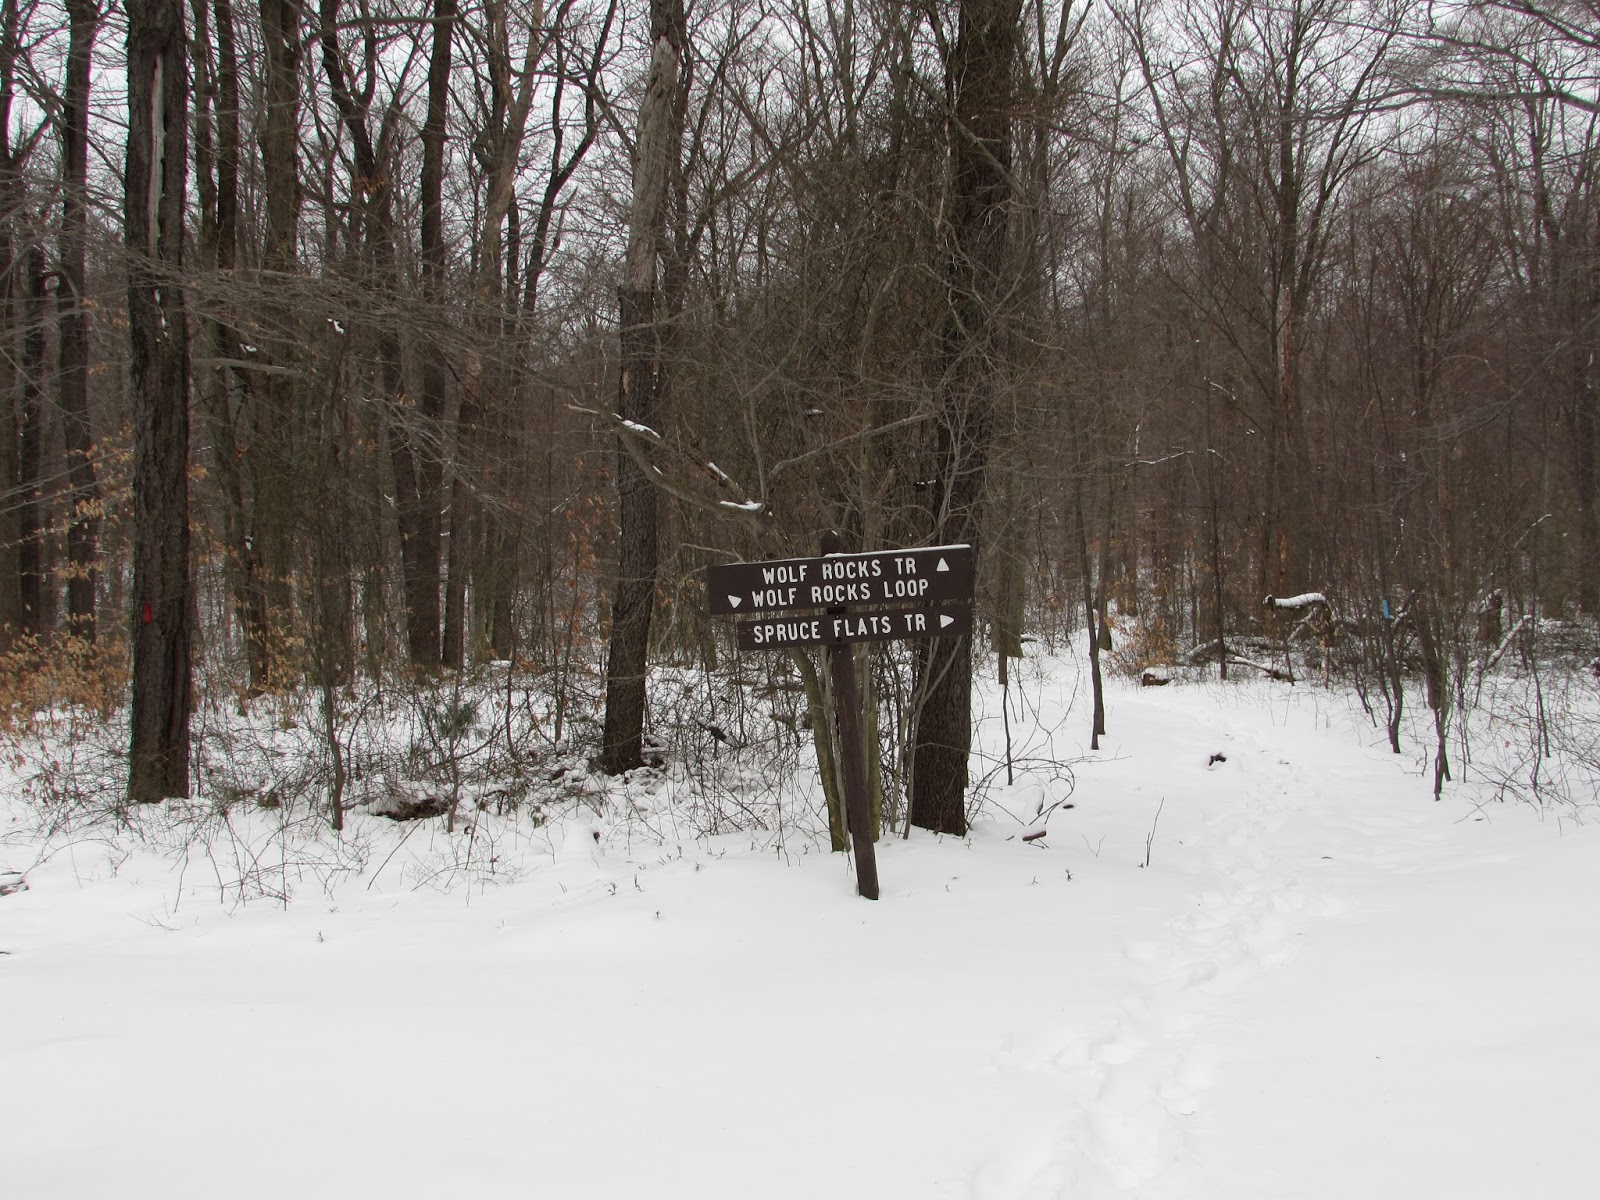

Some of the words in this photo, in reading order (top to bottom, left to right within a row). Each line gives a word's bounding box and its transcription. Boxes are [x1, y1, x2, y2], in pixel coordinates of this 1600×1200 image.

[762, 565, 808, 585] WOLF
[822, 559, 882, 580] ROCKS
[894, 557, 916, 575] TR
[751, 587, 798, 608] WOLF
[811, 582, 871, 603] ROCKS
[883, 578, 929, 599] LOOP
[753, 621, 821, 644] SPRUCE
[833, 615, 892, 638] FLATS
[904, 613, 926, 632] TR
